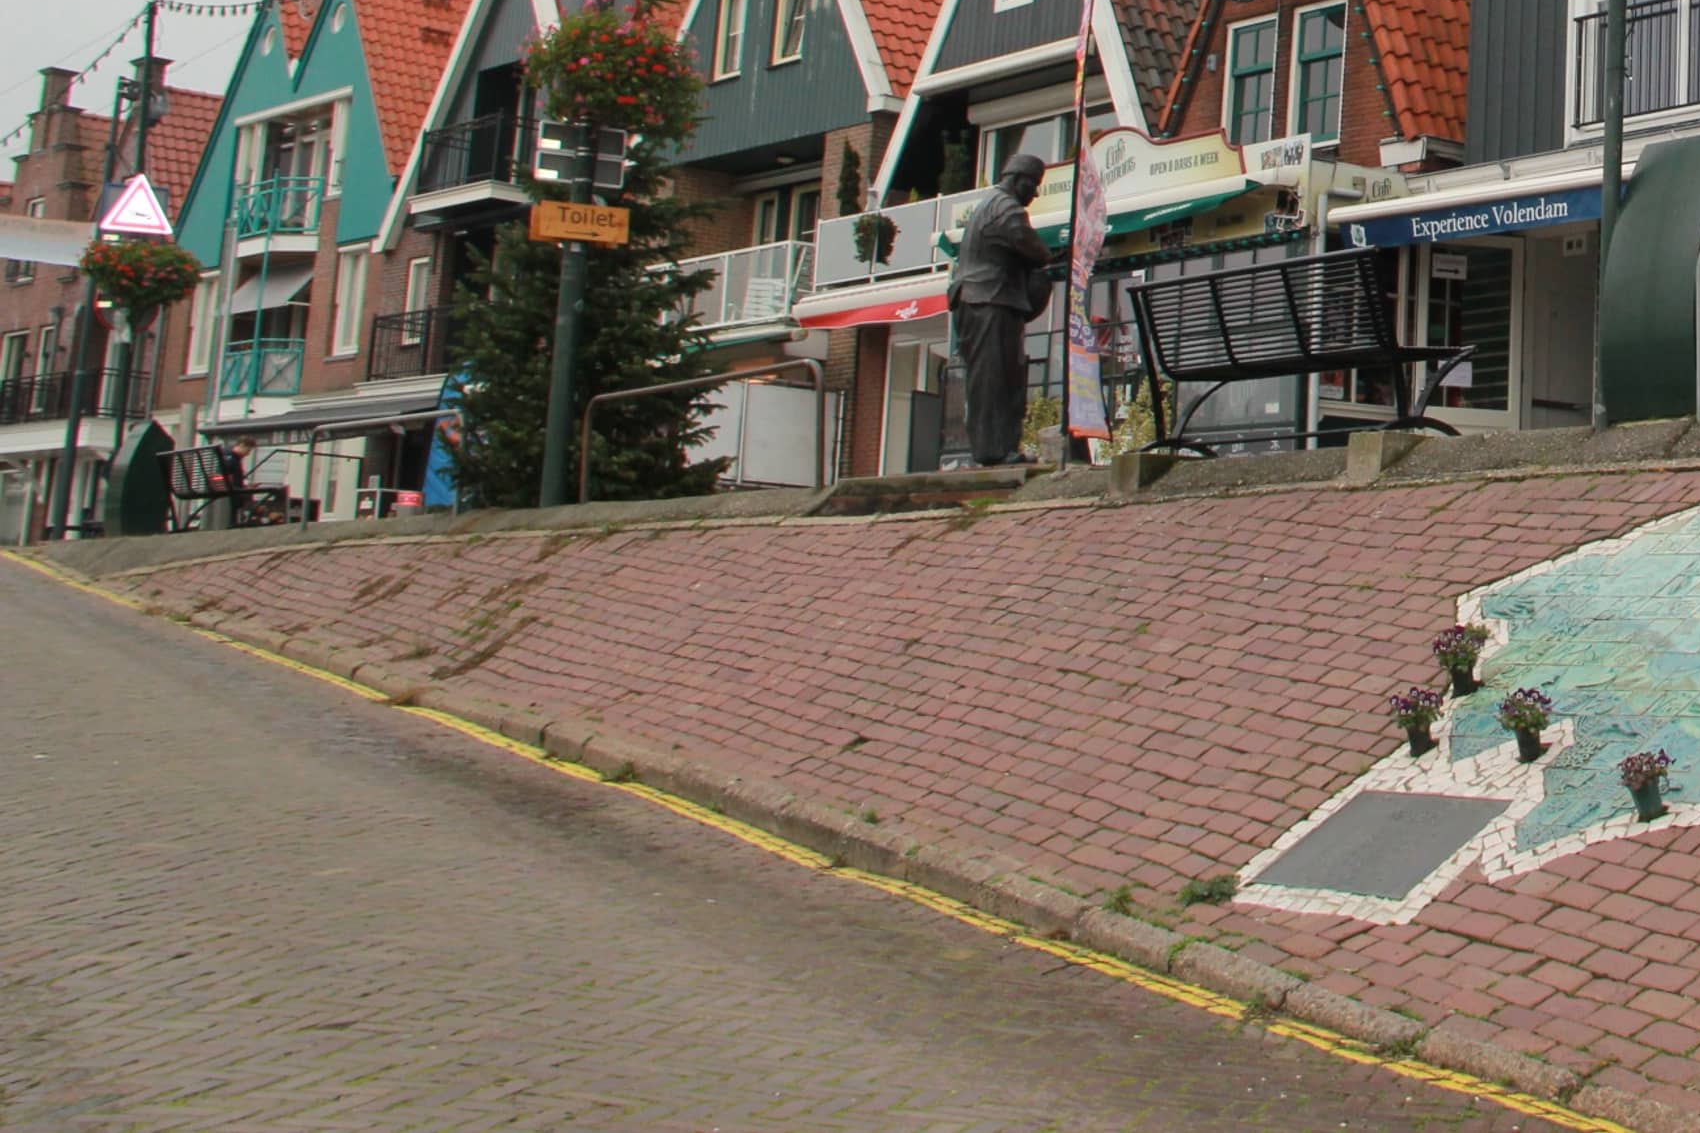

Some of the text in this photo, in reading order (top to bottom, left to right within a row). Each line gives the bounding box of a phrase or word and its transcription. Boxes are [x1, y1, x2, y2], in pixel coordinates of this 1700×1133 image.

[1199, 151, 1220, 166] WEEK
[557, 206, 616, 228] Toilet
[1411, 198, 1569, 242] Experience Volendam
